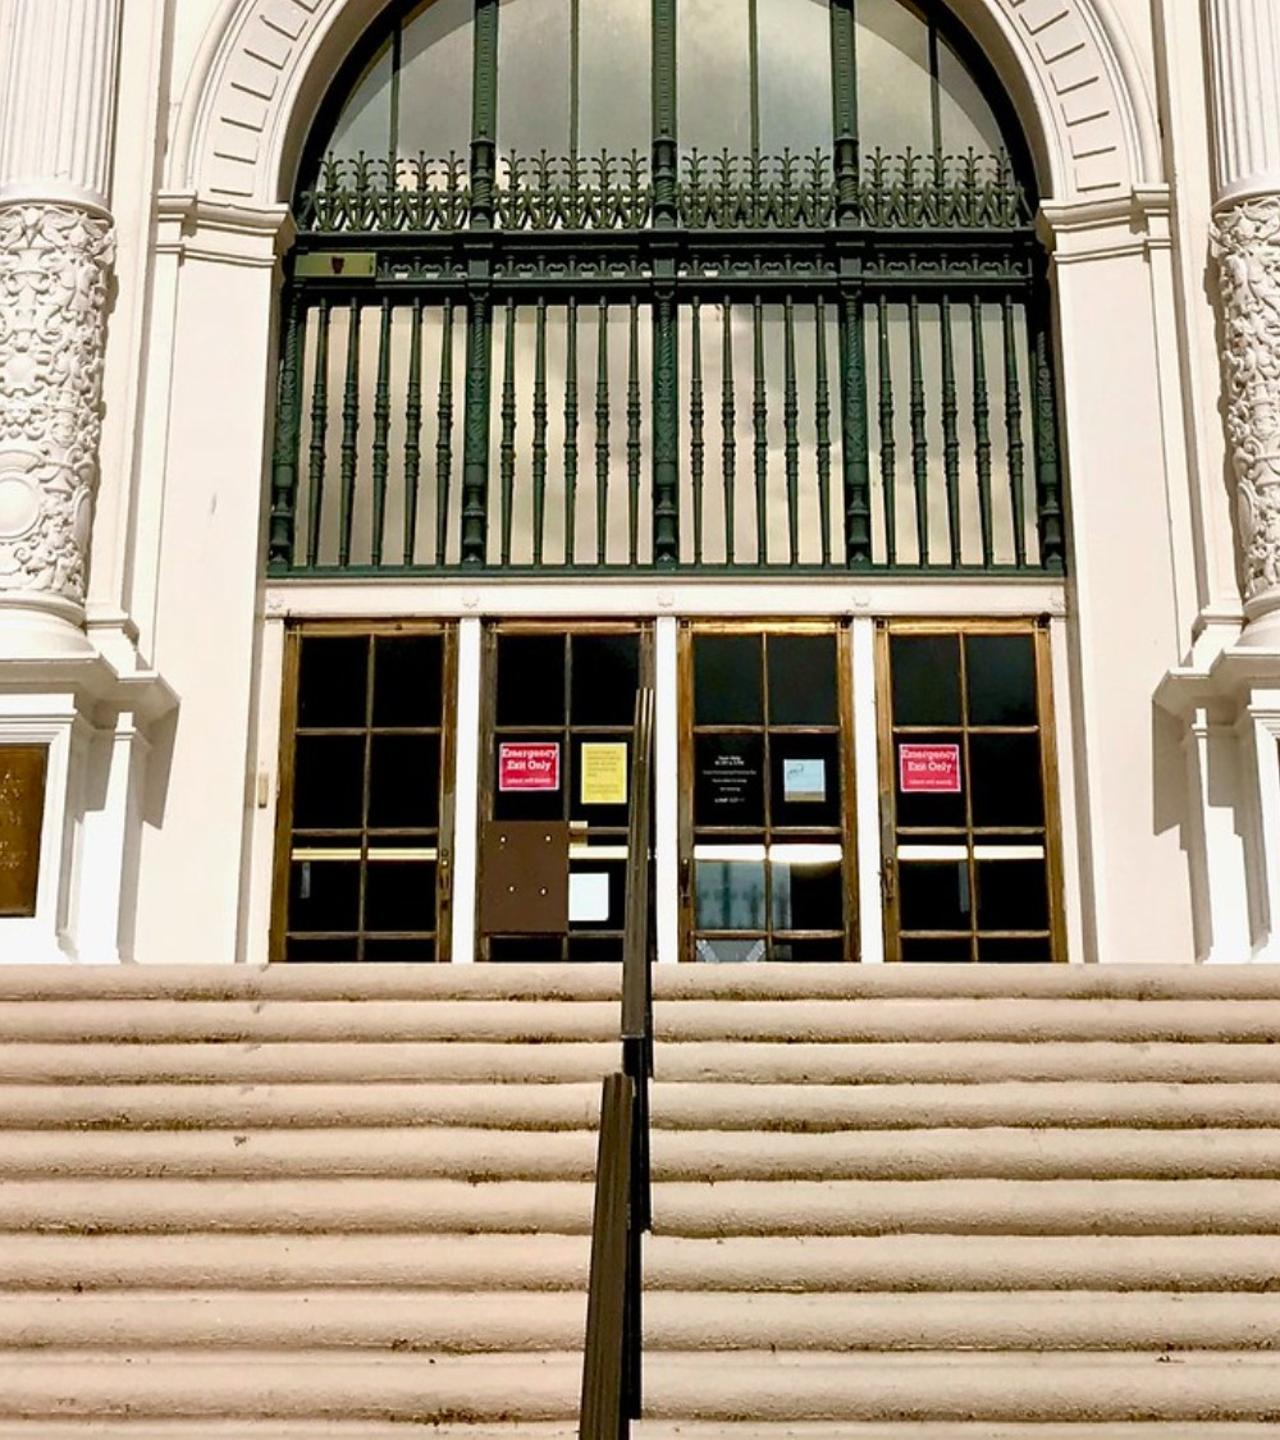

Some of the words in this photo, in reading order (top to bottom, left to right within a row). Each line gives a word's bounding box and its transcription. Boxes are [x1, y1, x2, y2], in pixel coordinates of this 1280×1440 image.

[502, 748, 555, 760] Emergency
[507, 760, 527, 770] Exit
[527, 760, 552, 771] Only
[908, 761, 927, 771] Exit
[928, 761, 952, 773] Only
